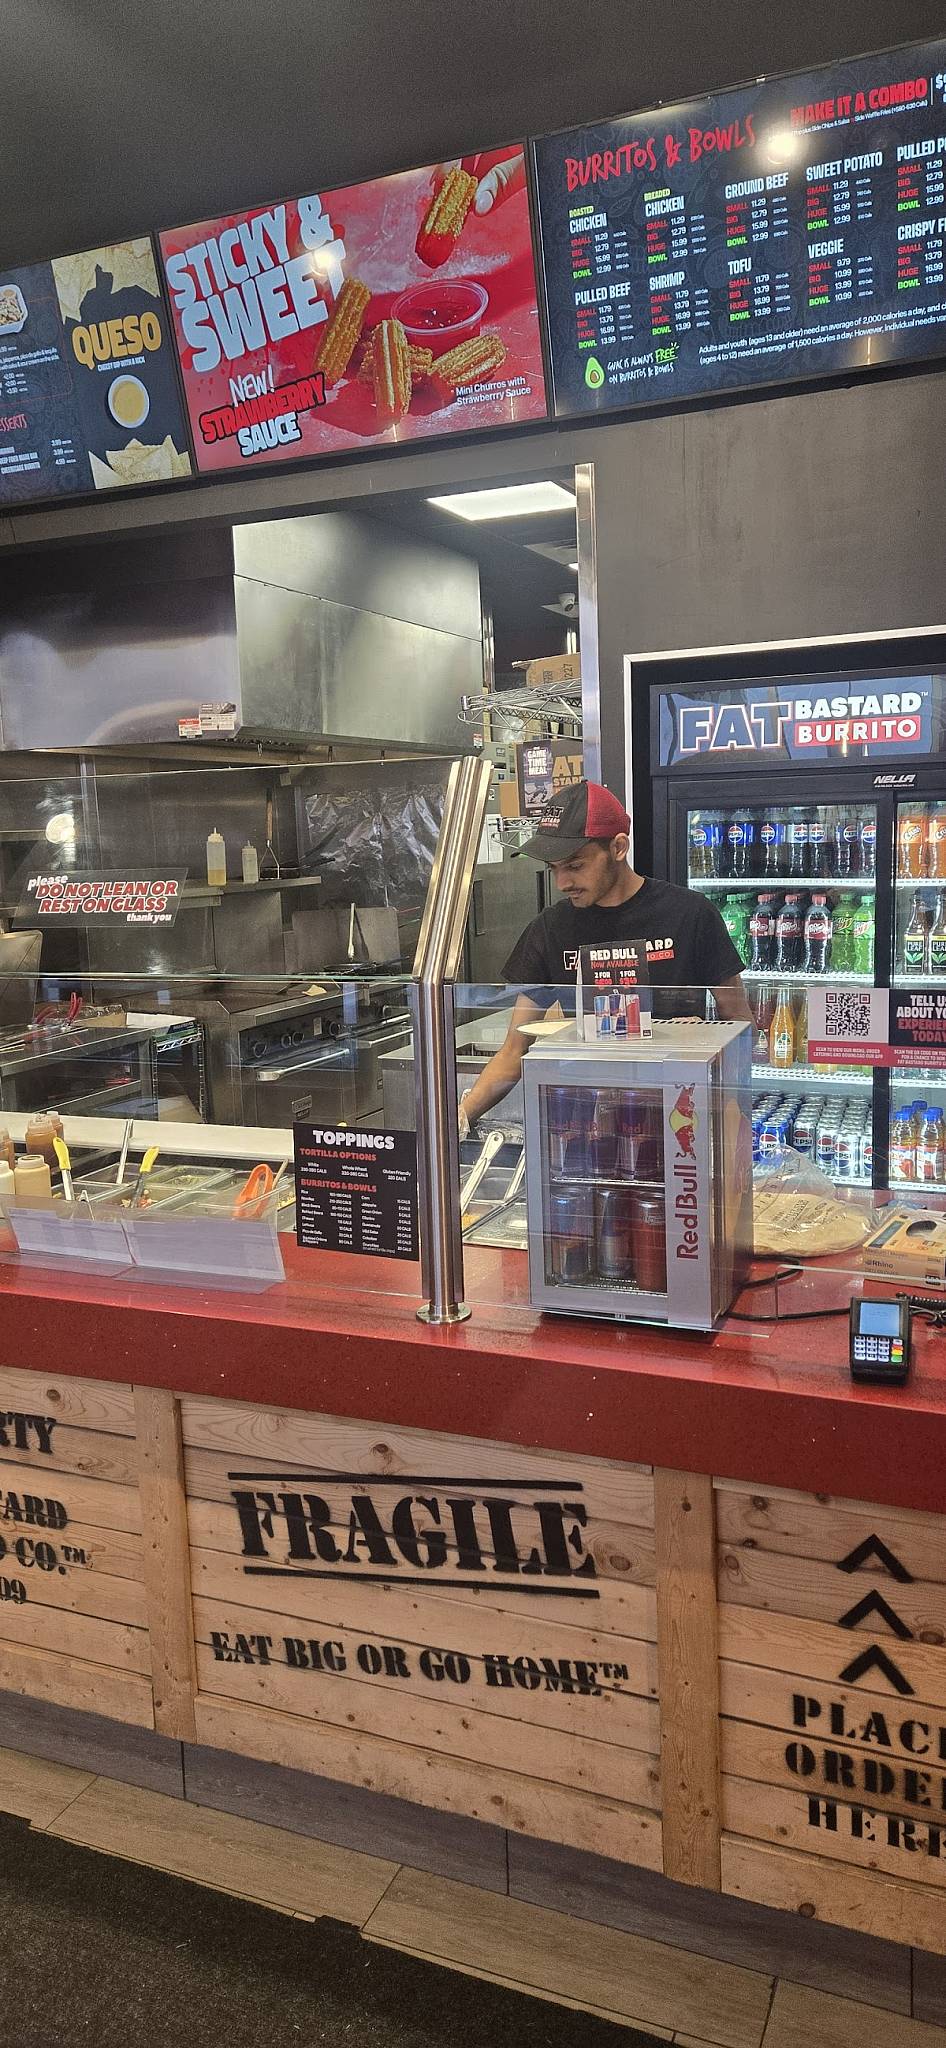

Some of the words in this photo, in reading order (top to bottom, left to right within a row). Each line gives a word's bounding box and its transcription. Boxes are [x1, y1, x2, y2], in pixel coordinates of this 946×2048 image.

[790, 99, 835, 128] MAKE
[837, 96, 852, 117] IT
[855, 92, 866, 112] A
[868, 78, 928, 107] COMBO
[565, 138, 656, 192] BURRITOS
[665, 135, 682, 168] &
[688, 114, 755, 162] BOWLS
[897, 140, 935, 162] PULLED
[806, 159, 842, 182] SWEET
[844, 152, 883, 173] POTATO
[644, 188, 671, 201] BREADED
[725, 179, 764, 199] GROUND
[766, 173, 789, 191] BEEF
[807, 185, 831, 195] SMALL
[833, 180, 849, 190] 11.29
[645, 196, 685, 217] CHICKEN
[807, 198, 819, 207] BIG
[834, 192, 850, 202] 12.79
[569, 205, 594, 218] ROASTED
[807, 208, 827, 218] HUGE
[834, 203, 851, 213] 15.99
[570, 213, 607, 234] CHICKEN
[808, 219, 829, 231] BOWL
[834, 215, 851, 225] 12.99
[897, 219, 935, 241] CRISPY
[166, 204, 290, 310] STICKY
[297, 194, 335, 250] &
[808, 239, 844, 259] VEGGIE
[728, 258, 752, 276] TOFU
[809, 262, 832, 272] SMALL
[837, 258, 851, 267] 9.79
[649, 272, 686, 291] SHRIMP
[809, 275, 821, 284] BIG
[835, 269, 852, 279] 10.99
[575, 286, 608, 306] PULLED
[610, 282, 631, 299] BEEF
[809, 285, 829, 295] HUGE
[835, 281, 852, 290] 13.99
[182, 238, 347, 373] SWEET
[809, 296, 830, 307] BOWL
[835, 292, 852, 301] 10.99
[699, 346, 718, 354] Adults
[730, 339, 748, 349] youth
[749, 337, 766, 346] (ages
[774, 332, 785, 341] and
[786, 329, 804, 339] older)
[804, 326, 820, 335] need
[829, 321, 854, 332] average
[854, 318, 862, 326] of
[863, 315, 882, 325] 2,000
[882, 310, 908, 321] calories
[913, 307, 927, 316] day,
[927, 304, 940, 313] and
[72, 312, 162, 370] QUESO
[608, 361, 623, 372] GUAC
[624, 360, 630, 369] IS
[631, 353, 654, 368] ALWAYS
[655, 347, 676, 363] FREE
[609, 376, 618, 385] ON
[619, 370, 647, 384] BURRITOS
[648, 368, 654, 378] &
[655, 362, 674, 376] BOWLS
[229, 364, 276, 407] NEW!
[456, 385, 473, 396] Mini
[474, 381, 506, 391] Churros
[508, 377, 526, 387] with
[506, 387, 531, 397] Sauce
[200, 375, 324, 442] STRAWBERRY
[238, 412, 301, 456] SAUCE
[680, 702, 793, 753] FAT
[799, 720, 917, 744] BURRITO
[527, 749, 548, 759] GAME
[528, 759, 547, 767] TIME
[529, 767, 548, 776] MEAL
[874, 775, 916, 784] NELLA
[28, 875, 68, 891] please
[36, 883, 64, 899] DO
[65, 883, 103, 898] NOT
[103, 882, 151, 897] LEAN
[150, 881, 179, 896] OR
[38, 899, 83, 914] REST
[82, 898, 112, 913] ON
[112, 897, 168, 913] GLASS
[127, 913, 153, 922] thank
[153, 914, 172, 924] you
[590, 949, 610, 961] RED
[612, 948, 638, 960] BULL
[592, 962, 605, 970] NOW
[607, 960, 640, 969] AVAILABLE
[911, 995, 935, 1007] TELL
[897, 1007, 934, 1018] ABOUT
[313, 1130, 395, 1150] TOPPINGS
[300, 1148, 339, 1159] TORTILLA
[340, 1152, 377, 1161] OPTIONS
[301, 1179, 341, 1190] BURRITOS
[349, 1184, 377, 1193] BOWLS
[674, 1164, 698, 1212] Bull
[677, 1214, 699, 1260] Red
[872, 1260, 894, 1269] Rhino
[0, 1490, 68, 1530] ARD
[231, 1491, 598, 1579] FRAGILE
[210, 1631, 272, 1666] EAT
[282, 1637, 347, 1672] BIG
[357, 1643, 411, 1678] OR
[419, 1649, 471, 1684] GO
[792, 1694, 946, 1760] PLAC
[785, 1742, 946, 1810] ORDE
